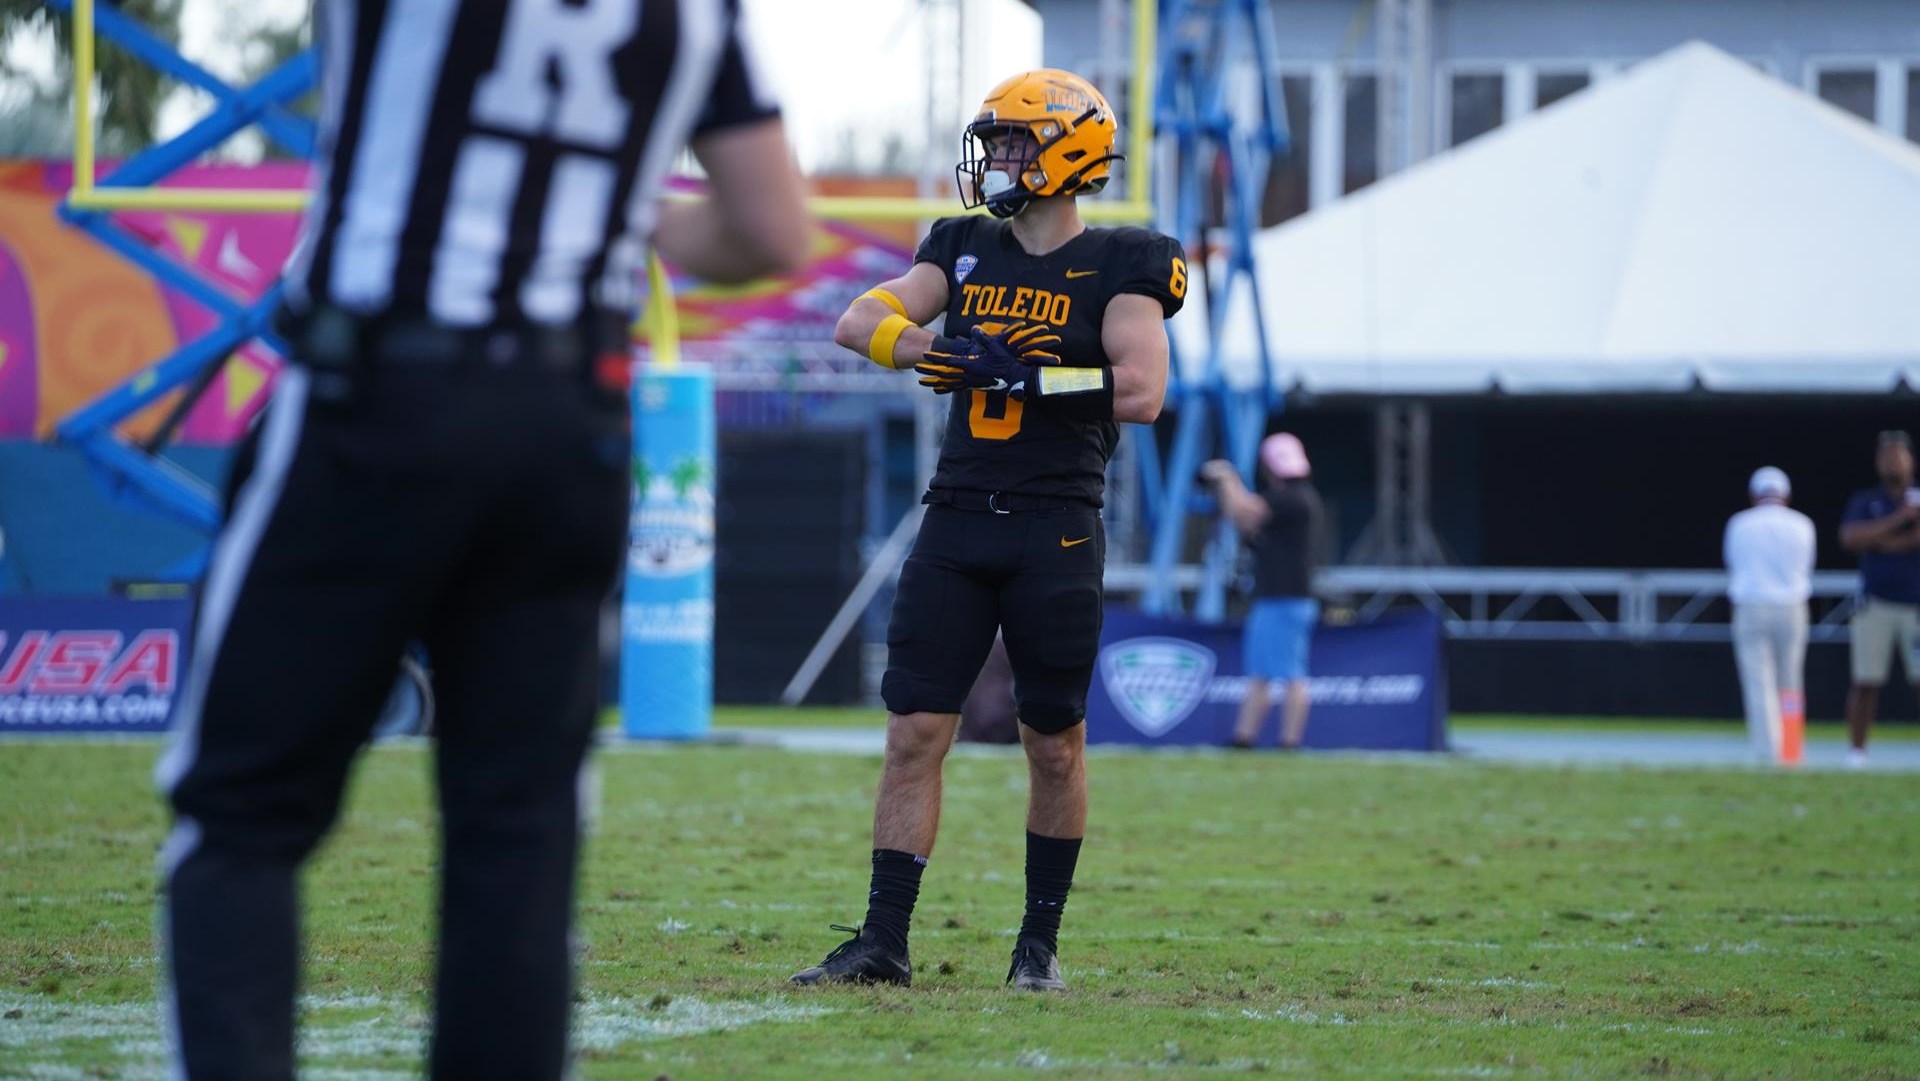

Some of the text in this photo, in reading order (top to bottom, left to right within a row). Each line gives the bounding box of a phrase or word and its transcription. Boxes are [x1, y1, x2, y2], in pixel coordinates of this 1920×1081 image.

[470, 0, 639, 152] R
[1169, 256, 1187, 299] 6
[961, 283, 1071, 326] TOLEDO
